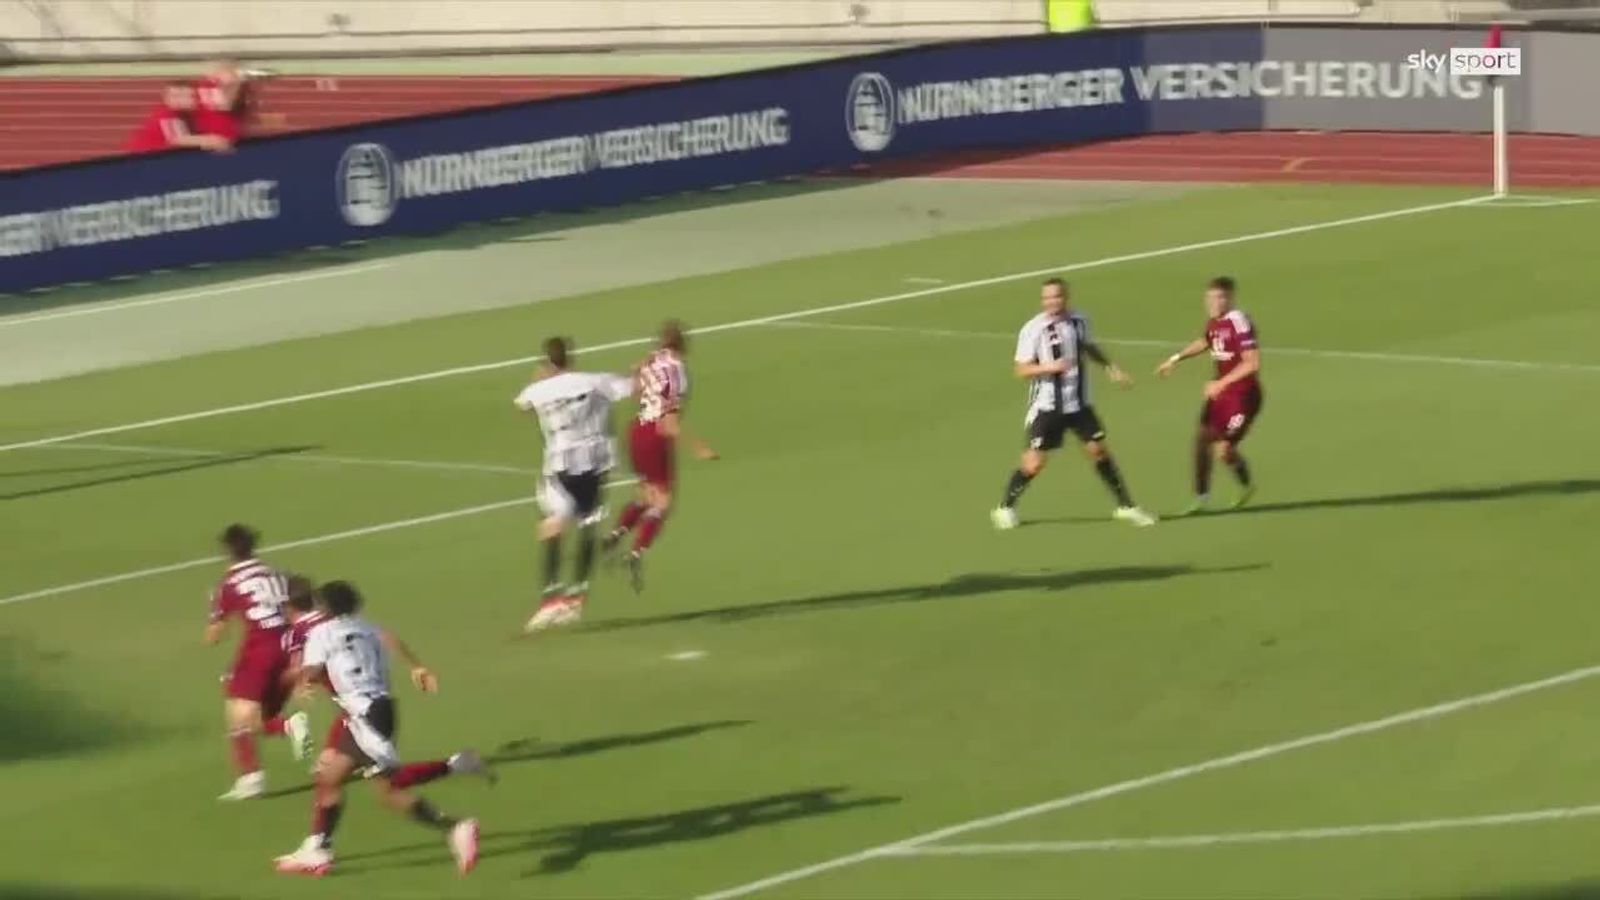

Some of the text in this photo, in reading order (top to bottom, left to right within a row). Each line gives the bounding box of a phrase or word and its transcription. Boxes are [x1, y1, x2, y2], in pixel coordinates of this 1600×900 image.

[1130, 61, 1483, 100] VERSICHERUNG
[587, 107, 790, 168] VERSICHERUNG
[55, 179, 280, 249] VERSICHERUNG
